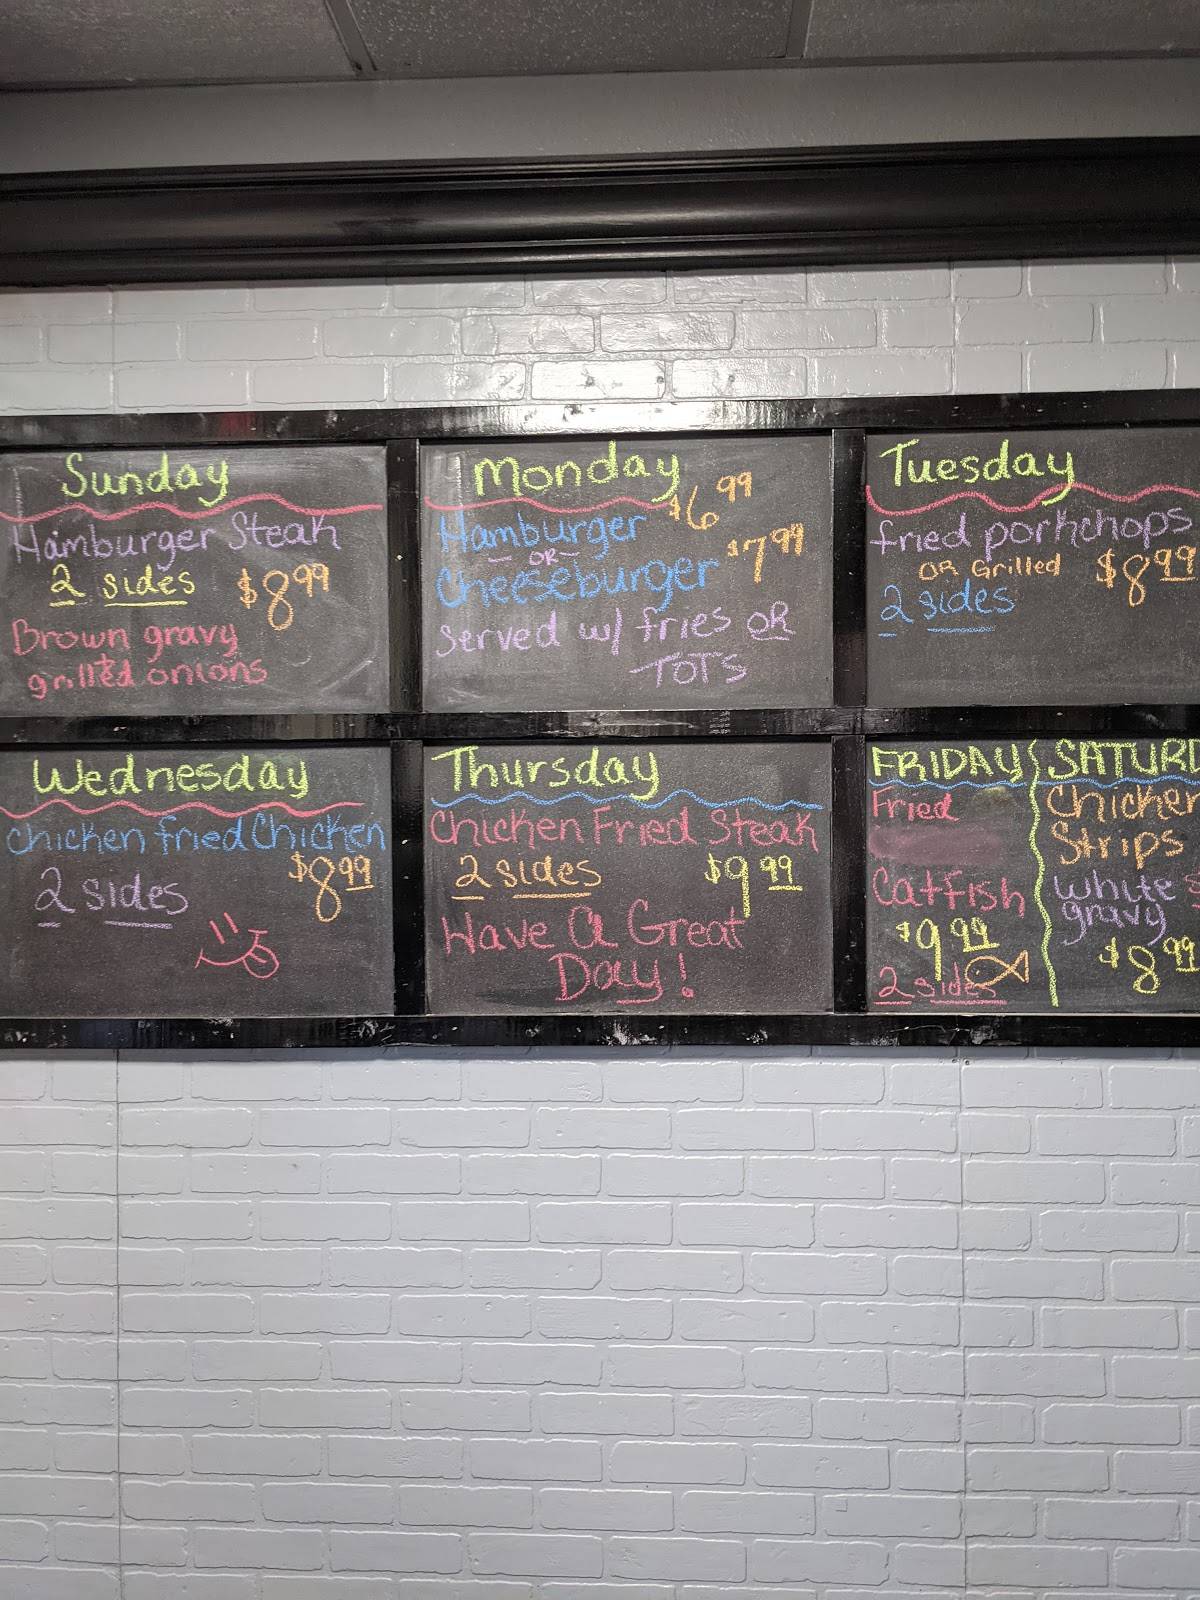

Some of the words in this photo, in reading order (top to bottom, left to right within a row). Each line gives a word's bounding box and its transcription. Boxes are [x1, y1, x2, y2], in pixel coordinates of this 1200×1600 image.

[62, 452, 230, 507] Sunday
[473, 440, 681, 503] Monday
[879, 438, 1076, 507] Tuesday
[11, 523, 217, 572] Hamburger
[228, 511, 343, 551] Steak
[438, 510, 649, 561] Hamburger
[869, 512, 972, 555] fried
[529, 549, 559, 566] OR
[971, 552, 1061, 579] Grilled
[50, 564, 86, 598] 2
[102, 564, 196, 599] sides
[435, 557, 719, 613] Cheeseburger
[880, 585, 913, 624] 2
[918, 578, 1017, 620] sides
[12, 618, 129, 656] Brown
[144, 623, 239, 662] gravy
[578, 608, 620, 655] w/
[636, 606, 732, 642] fries
[747, 601, 796, 637] OR
[147, 659, 269, 687] onions
[32, 753, 309, 800] Wednesday
[431, 745, 660, 802] Thursday
[871, 744, 1023, 783] FRIDAY
[871, 786, 960, 822] Fried
[155, 815, 245, 855] fried
[251, 813, 386, 852] Chicken
[429, 807, 584, 850] Chicken
[591, 806, 698, 847] Fried
[707, 808, 820, 854] Steak
[1051, 821, 1184, 871] Strips
[34, 866, 76, 914] 2
[454, 855, 491, 888] 2
[496, 855, 602, 888] sides
[441, 912, 555, 955] Have
[626, 898, 746, 950] Great
[1061, 901, 1168, 947] gravy
[879, 966, 915, 999] 2
